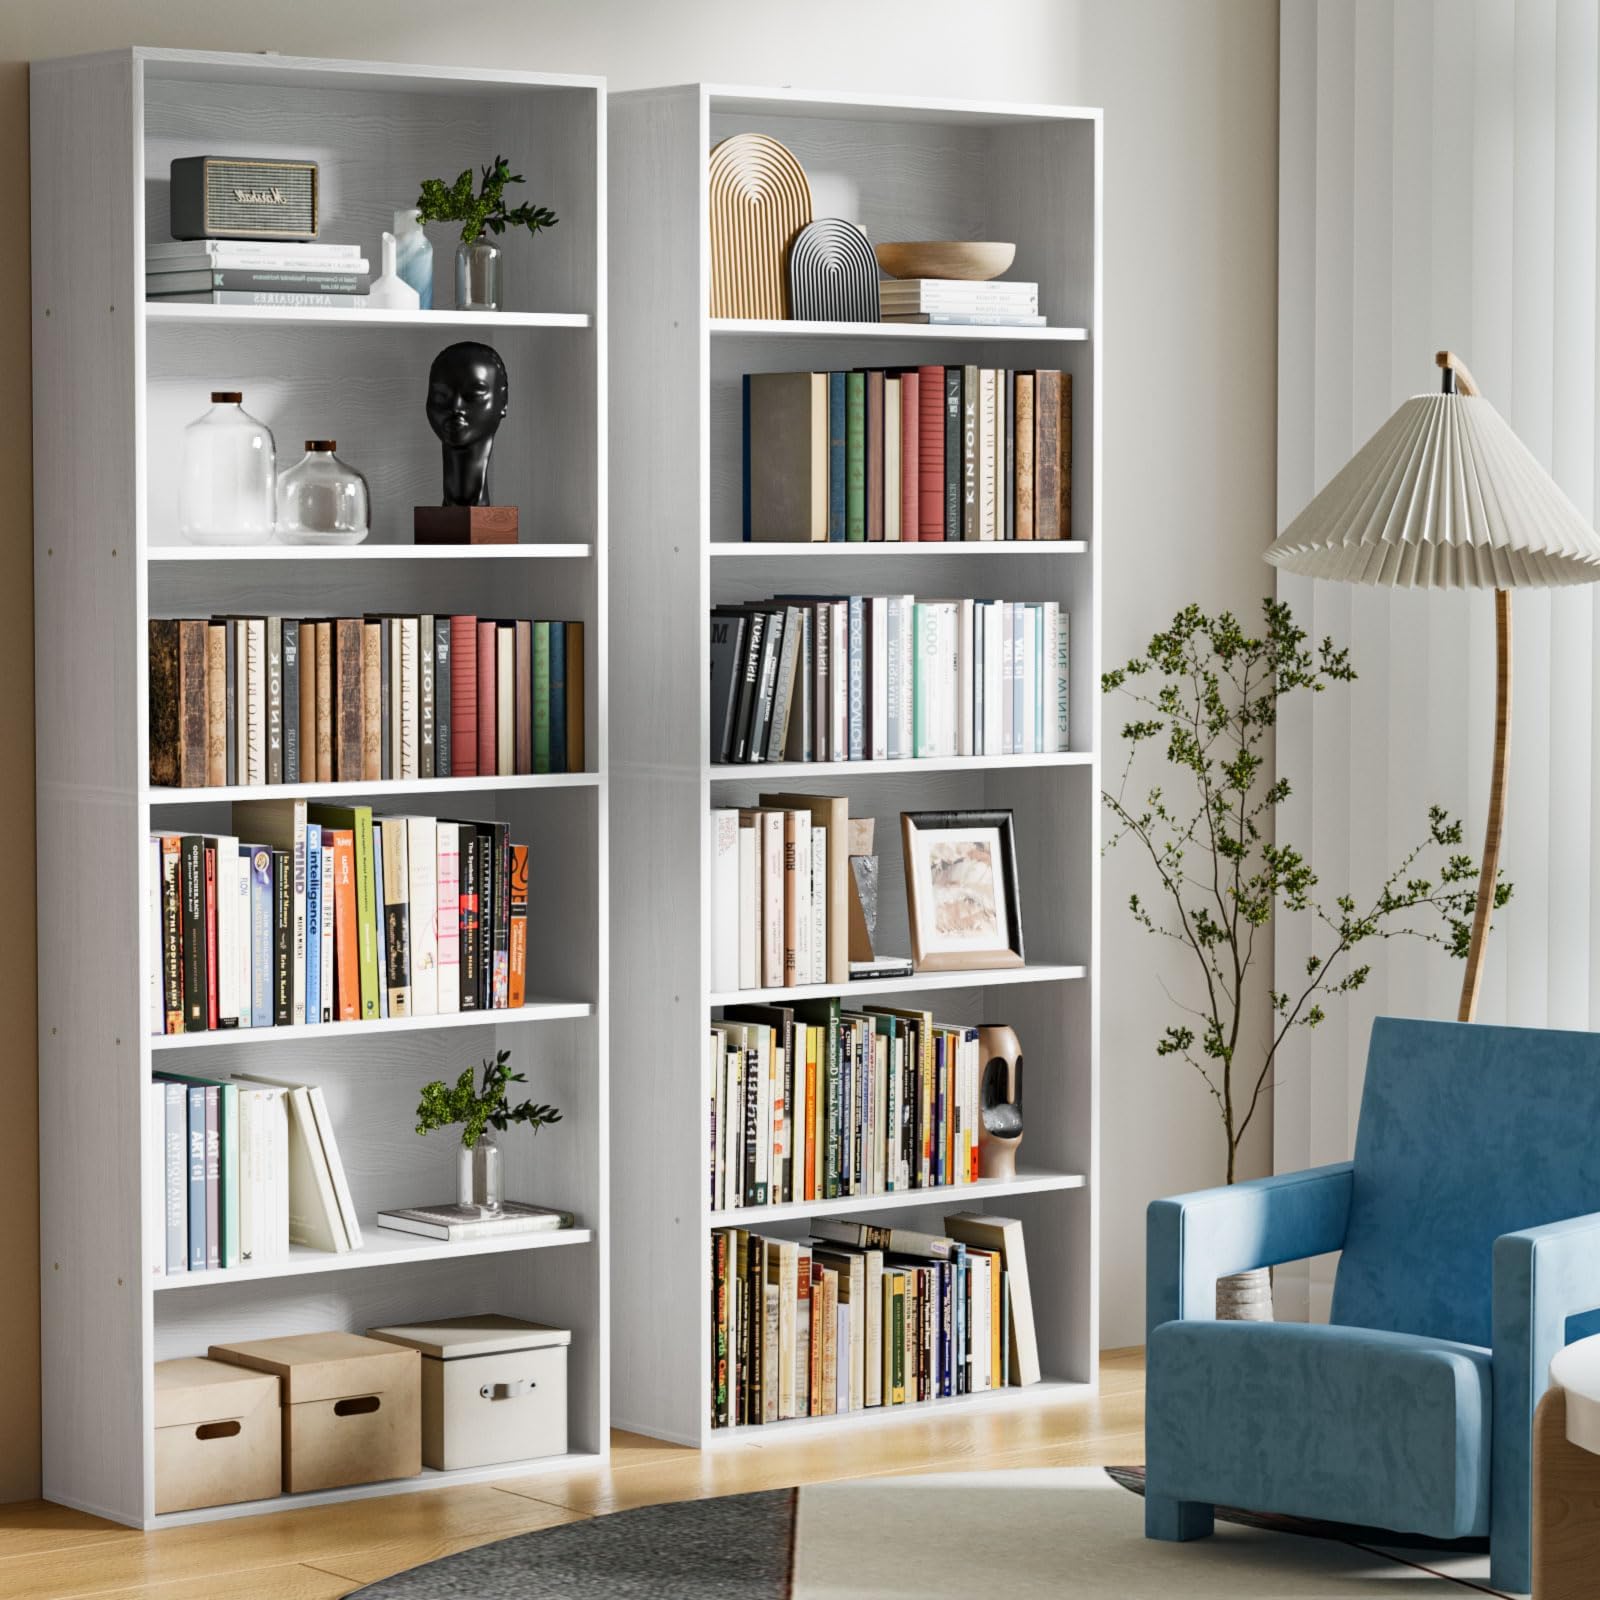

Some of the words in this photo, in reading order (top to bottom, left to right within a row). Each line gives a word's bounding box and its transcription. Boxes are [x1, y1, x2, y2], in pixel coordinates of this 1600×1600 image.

[966, 401, 975, 504] KINFOLK
[310, 830, 318, 849] on
[240, 877, 248, 896] FLOW
[295, 841, 305, 895] MIND
[307, 850, 320, 935] intelligence
[718, 1323, 727, 1356] Earth
